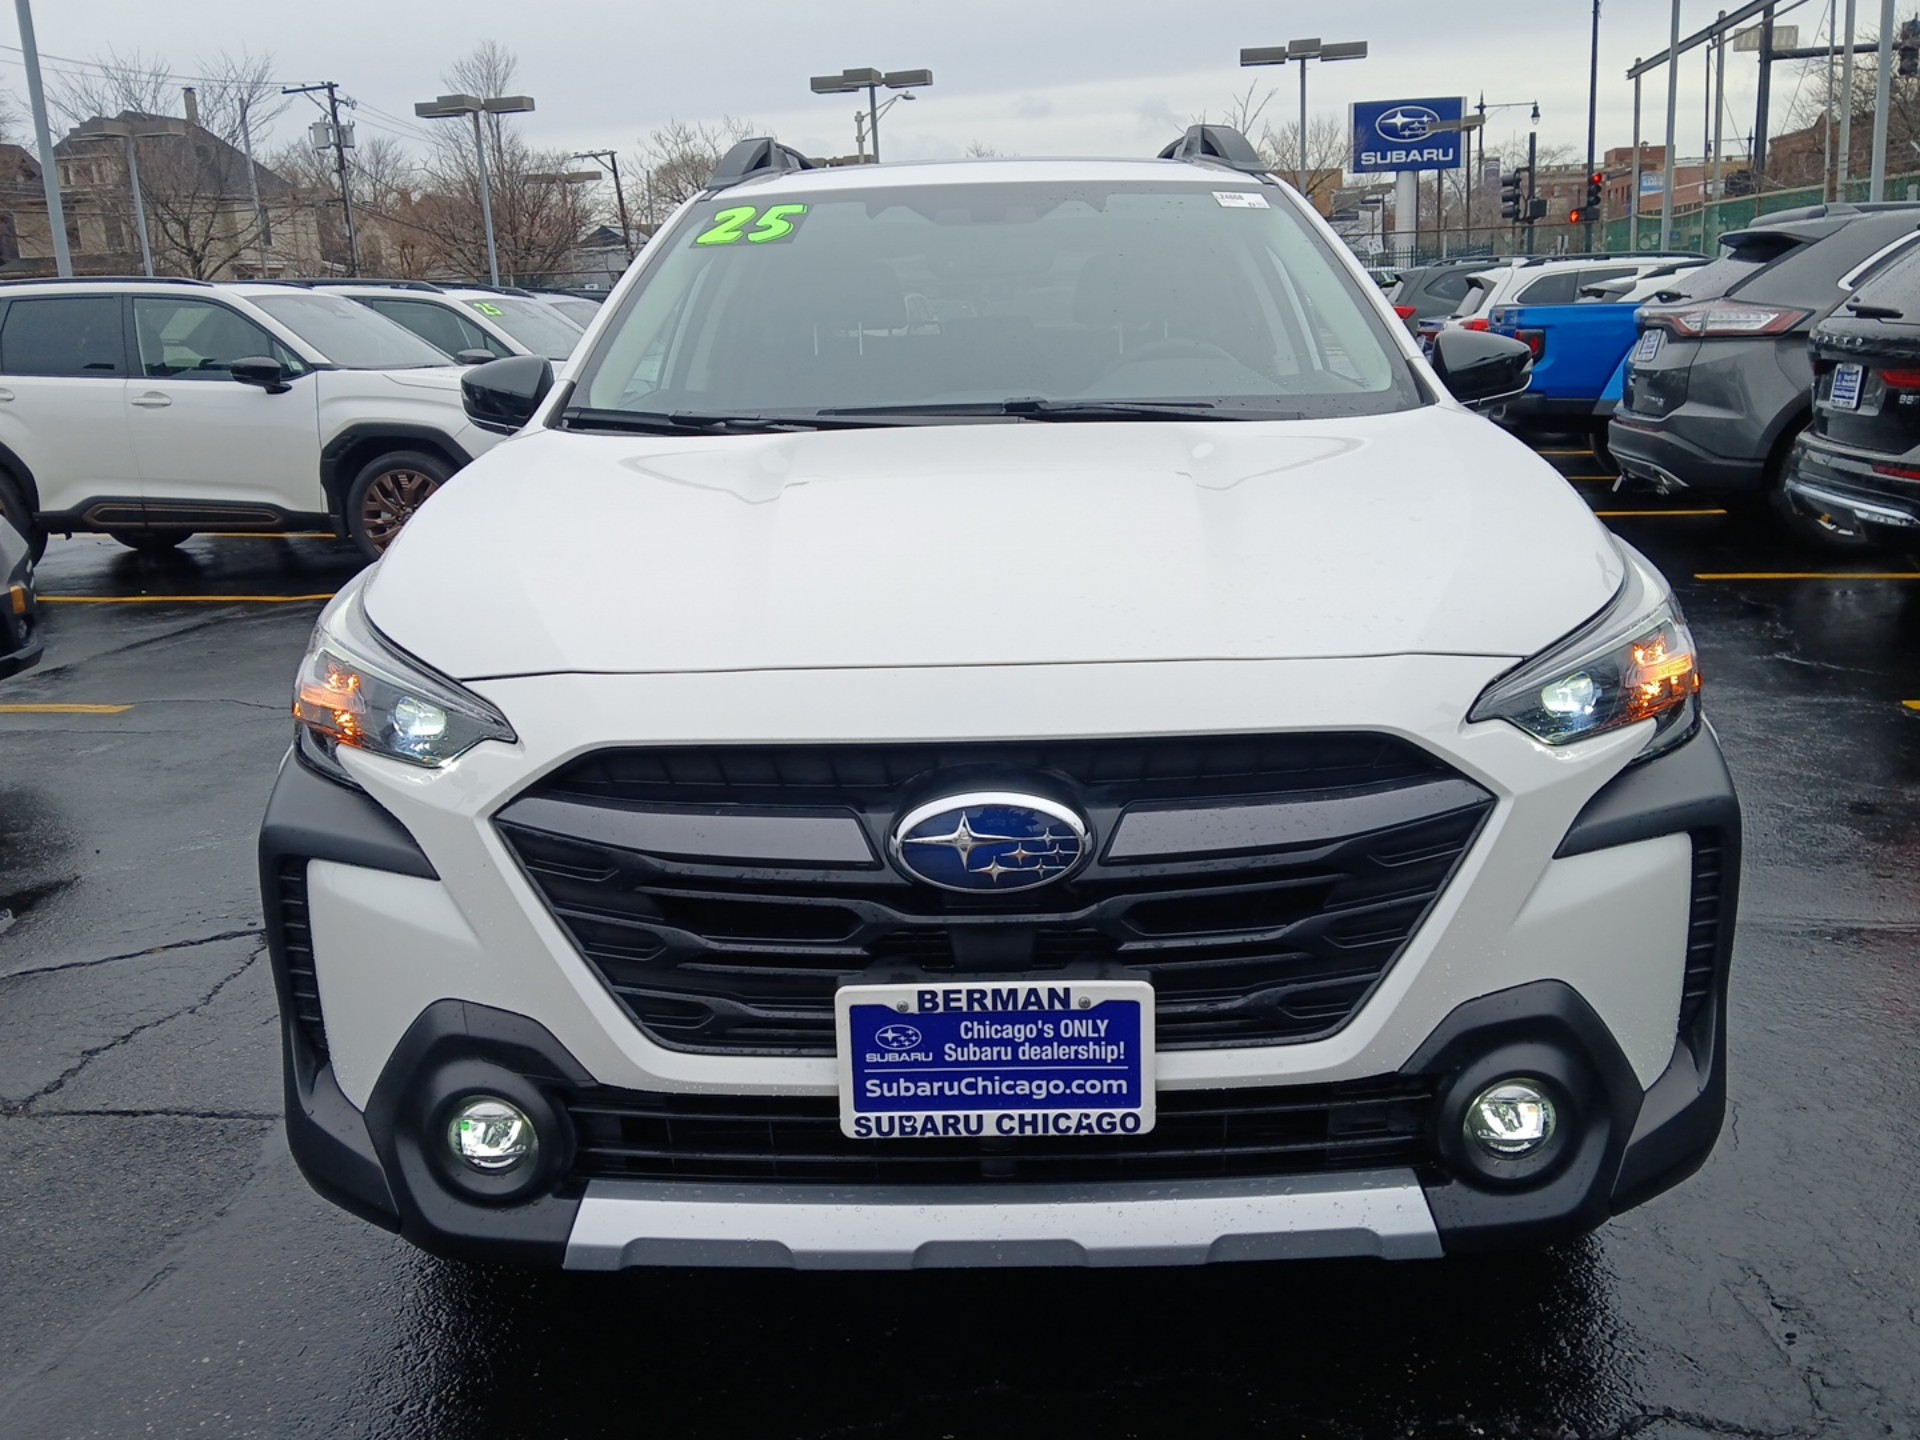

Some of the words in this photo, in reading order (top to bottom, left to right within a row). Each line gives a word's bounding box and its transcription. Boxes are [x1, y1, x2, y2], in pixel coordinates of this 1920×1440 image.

[1360, 148, 1454, 165] SUBARU
[696, 204, 808, 245] 25
[473, 302, 505, 317] 25
[916, 987, 1071, 1013] BERMAN
[960, 1020, 1054, 1042] Chicago's
[1059, 1019, 1109, 1038] ONLY
[865, 1052, 933, 1063] SUBARU
[943, 1043, 1012, 1061] Subaru
[1018, 1041, 1125, 1063] dealership!
[865, 1076, 1128, 1099] SubaruChicago.com
[854, 1114, 984, 1137] SUBARU
[995, 1112, 1141, 1136] CHICAGO
